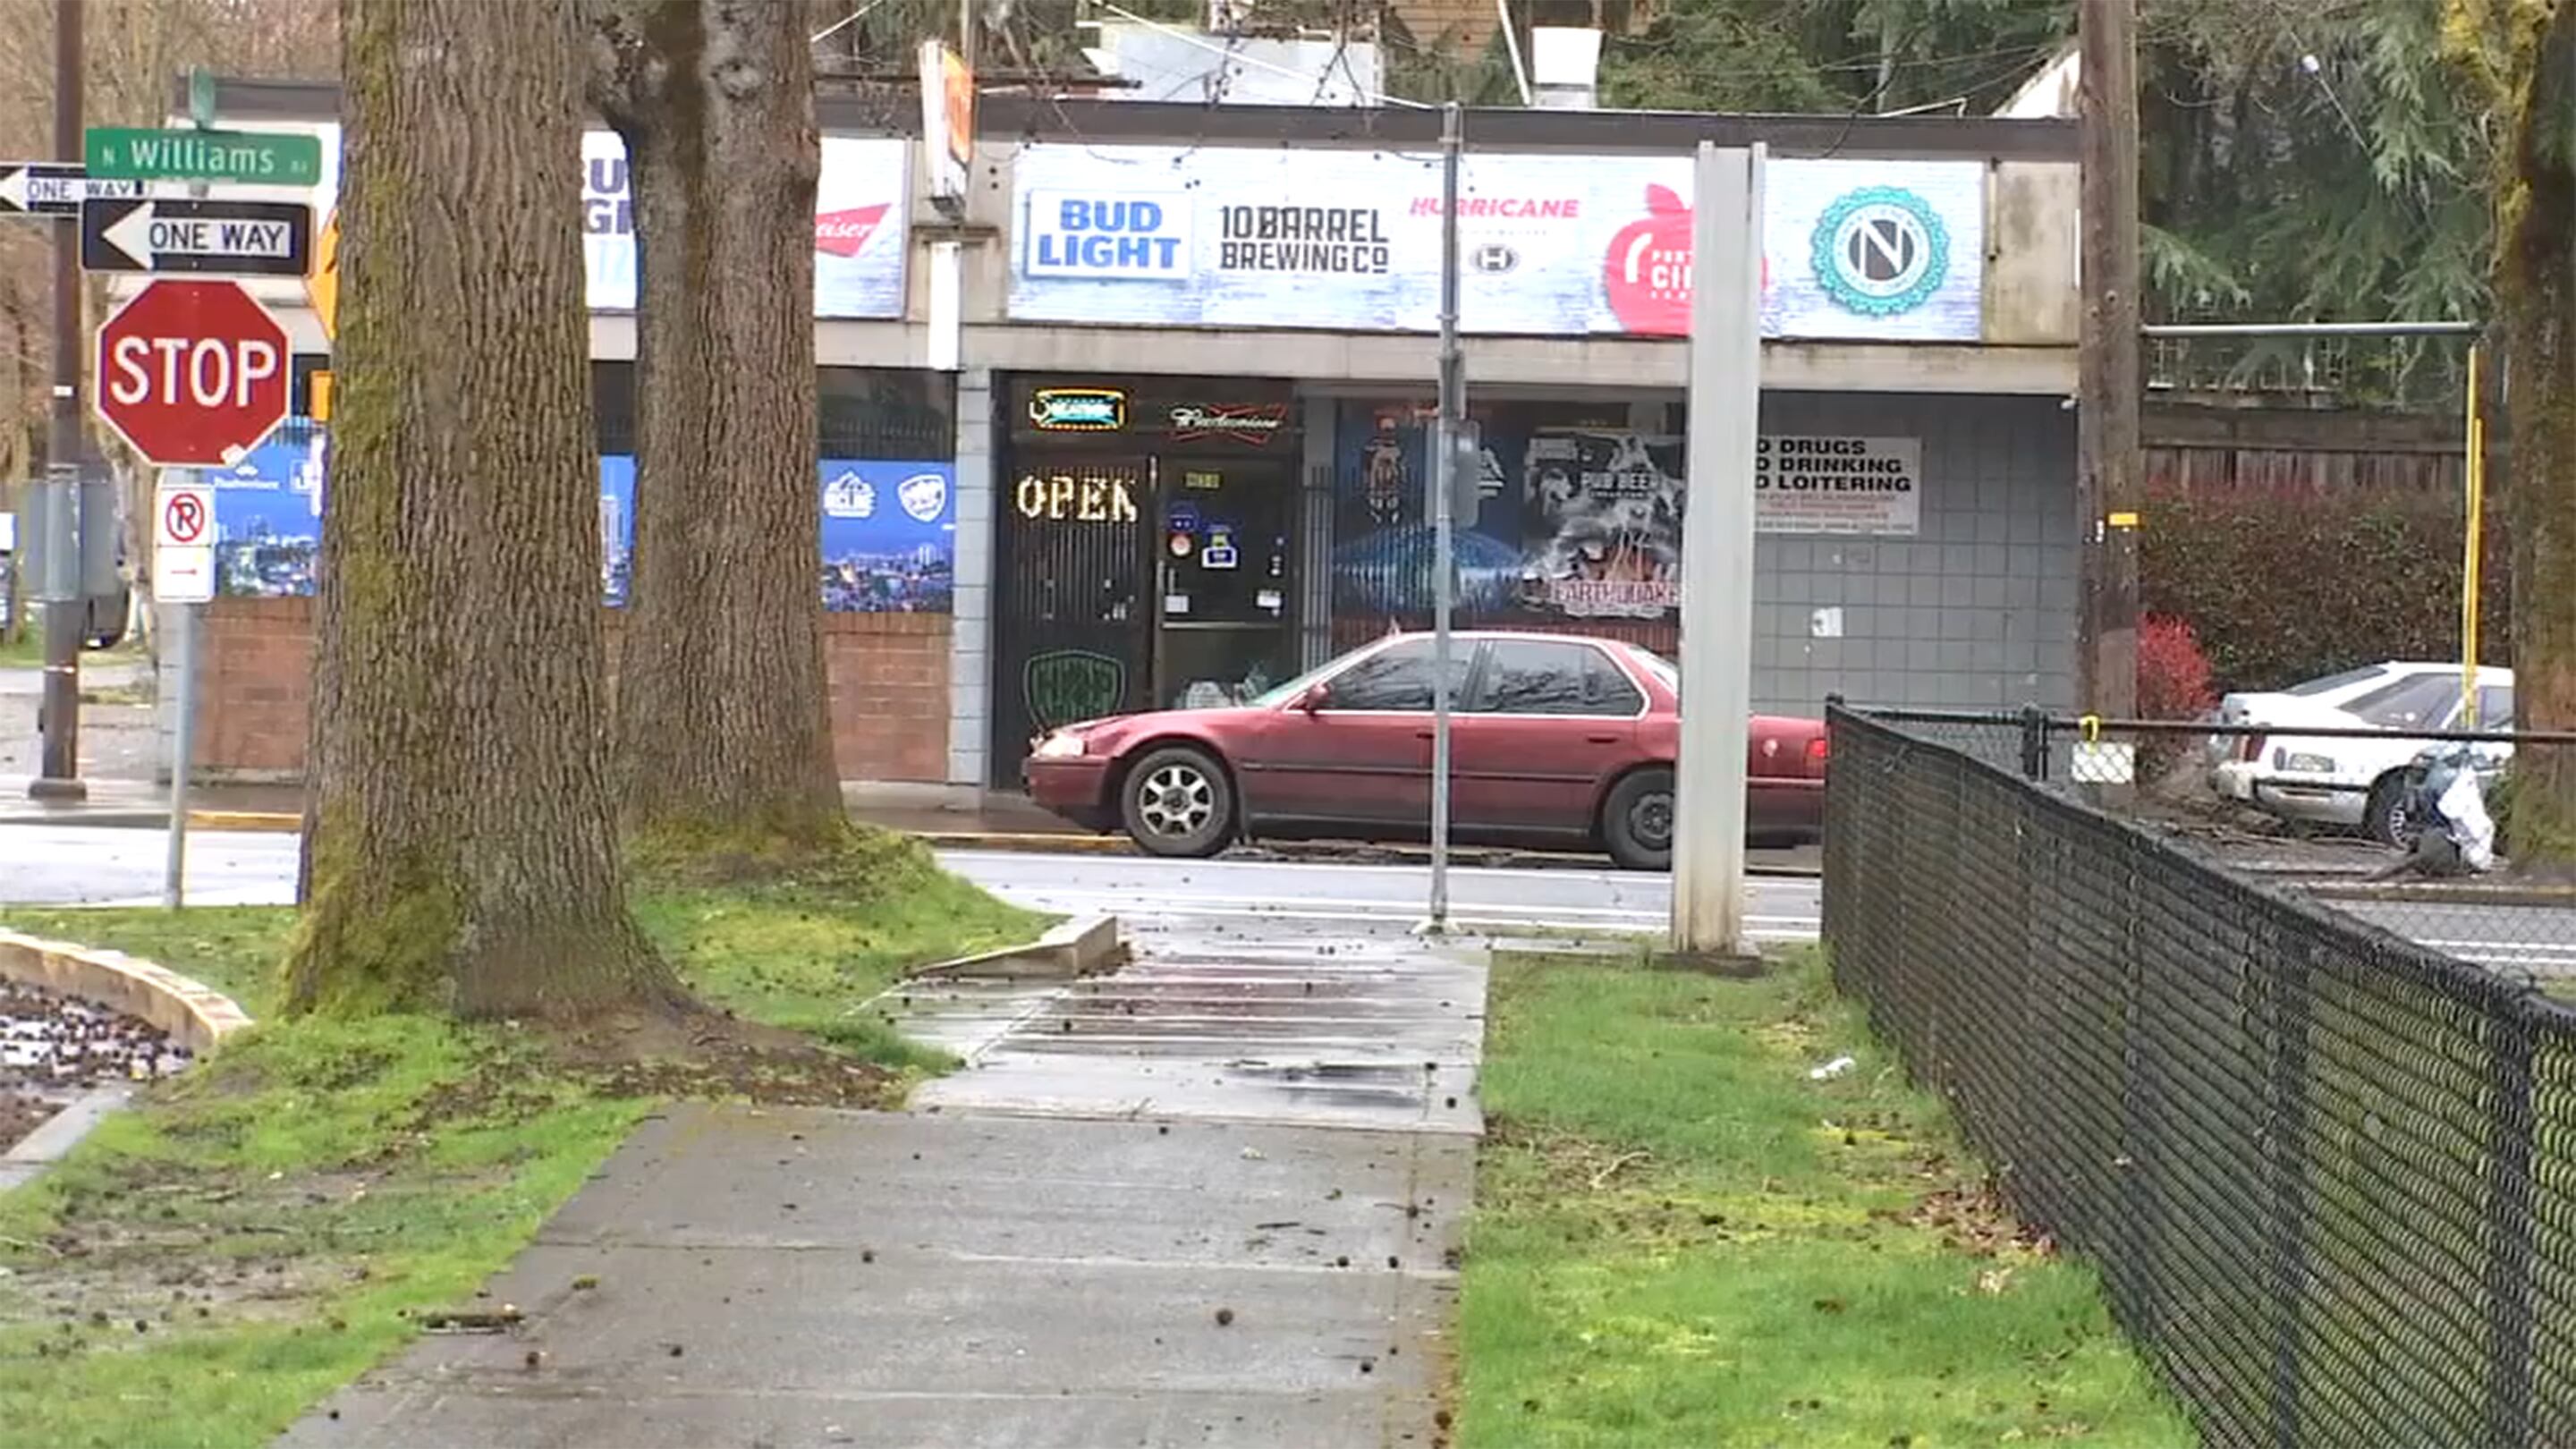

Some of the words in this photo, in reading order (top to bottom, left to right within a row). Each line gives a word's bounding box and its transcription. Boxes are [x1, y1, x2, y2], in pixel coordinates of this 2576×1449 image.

[102, 148, 115, 166] N
[131, 140, 275, 174] Williams
[27, 181, 72, 199] ONE
[85, 181, 131, 197] WAY
[1060, 199, 1163, 233] BUD
[1409, 197, 1580, 218] HURRICANE
[149, 223, 209, 250] ONE
[223, 225, 286, 252] WAY
[816, 216, 874, 238] eiser
[1038, 233, 1182, 268] LIGHT
[110, 336, 278, 407] STOP
[1757, 438, 1771, 453] O
[1781, 440, 1866, 455] DRUGS
[1757, 456, 1770, 471] O
[1780, 458, 1902, 473] DRINKING
[1756, 474, 1769, 489] O
[1778, 475, 1911, 491] LOITERING
[1017, 475, 1138, 521] OPEN
